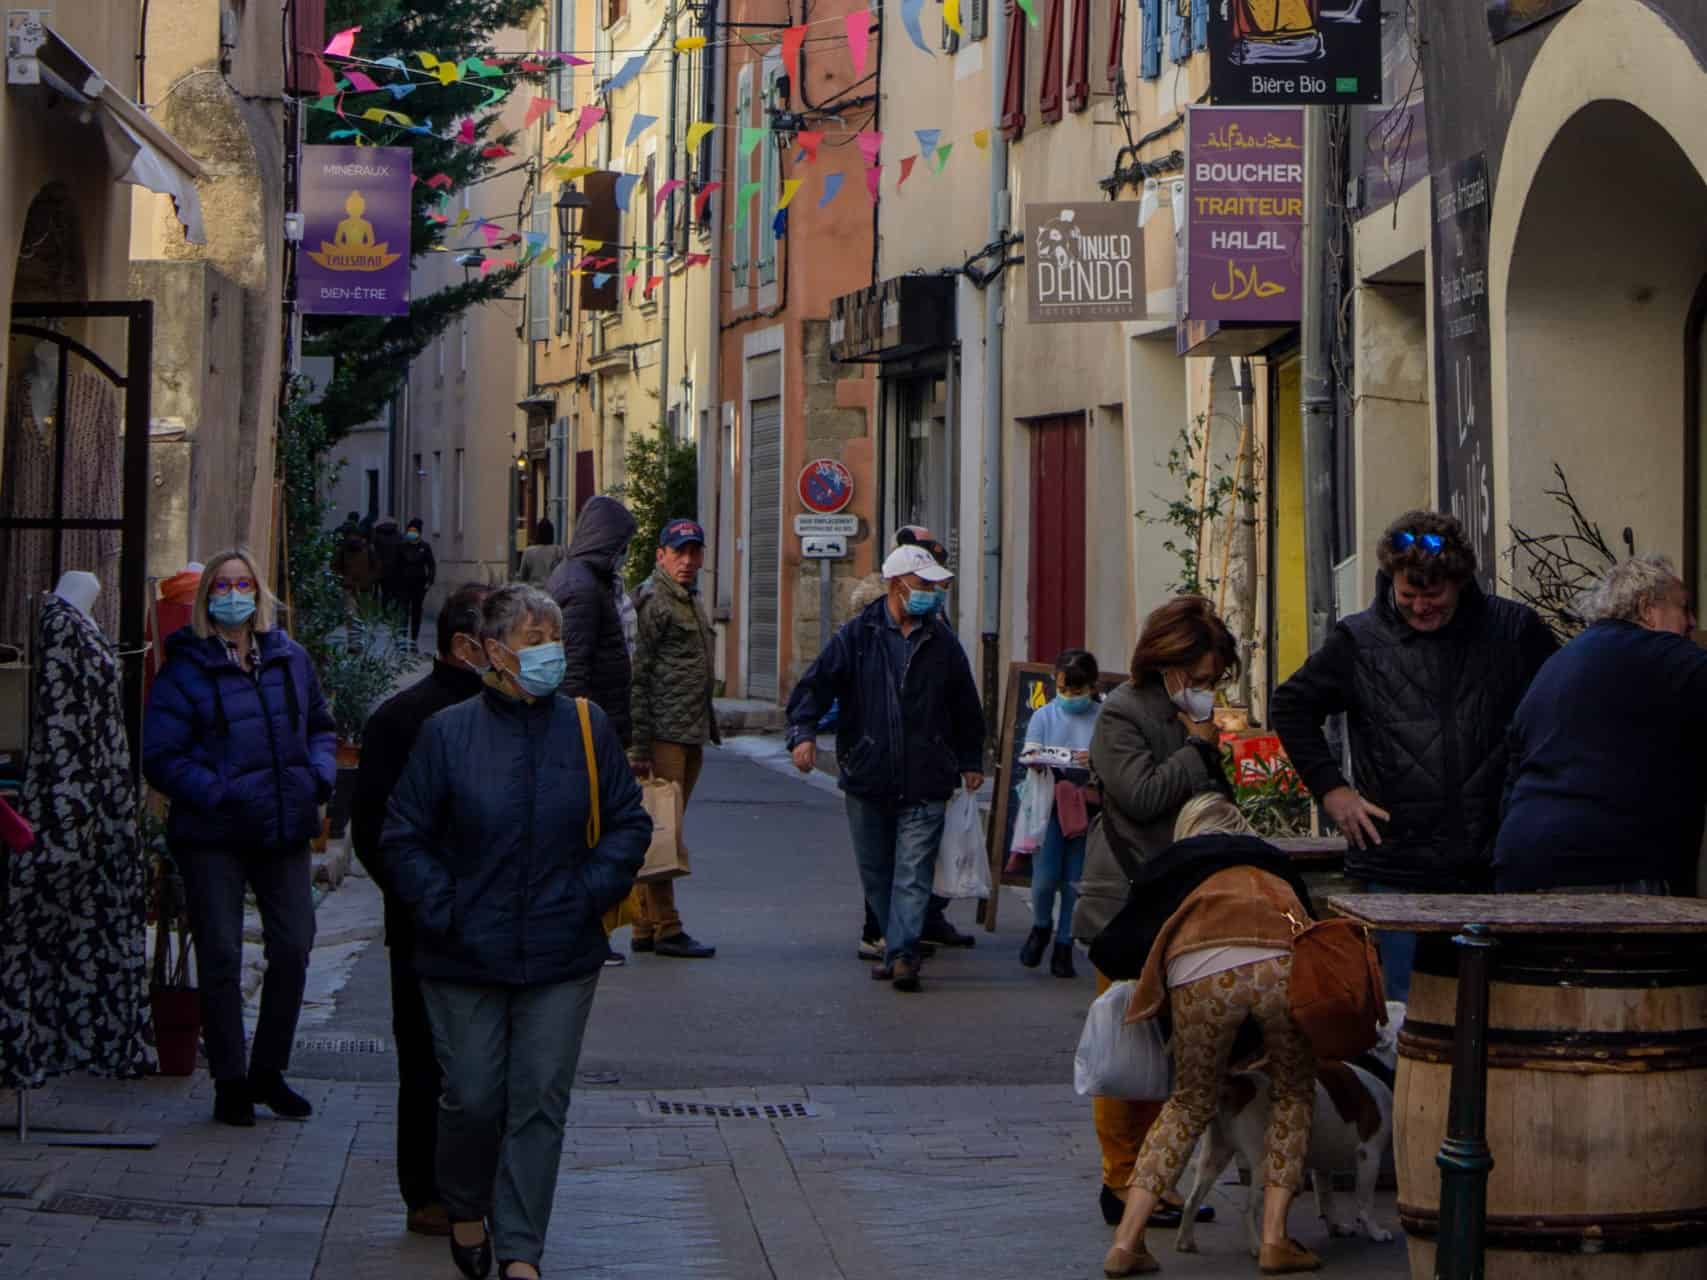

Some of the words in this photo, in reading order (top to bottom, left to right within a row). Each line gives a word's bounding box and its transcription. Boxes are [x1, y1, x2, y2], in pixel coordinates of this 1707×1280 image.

[1251, 75, 1295, 94] Bière
[1299, 76, 1327, 94] Bio
[1195, 163, 1302, 183] BOUCHER
[1194, 196, 1303, 217] TRAITEUR
[1081, 234, 1132, 261] INKED
[1211, 230, 1287, 250] HALAL
[1038, 260, 1133, 302] PANDA
[1211, 259, 1287, 302] حلال
[320, 286, 388, 301] BIEN-ÊTRE
